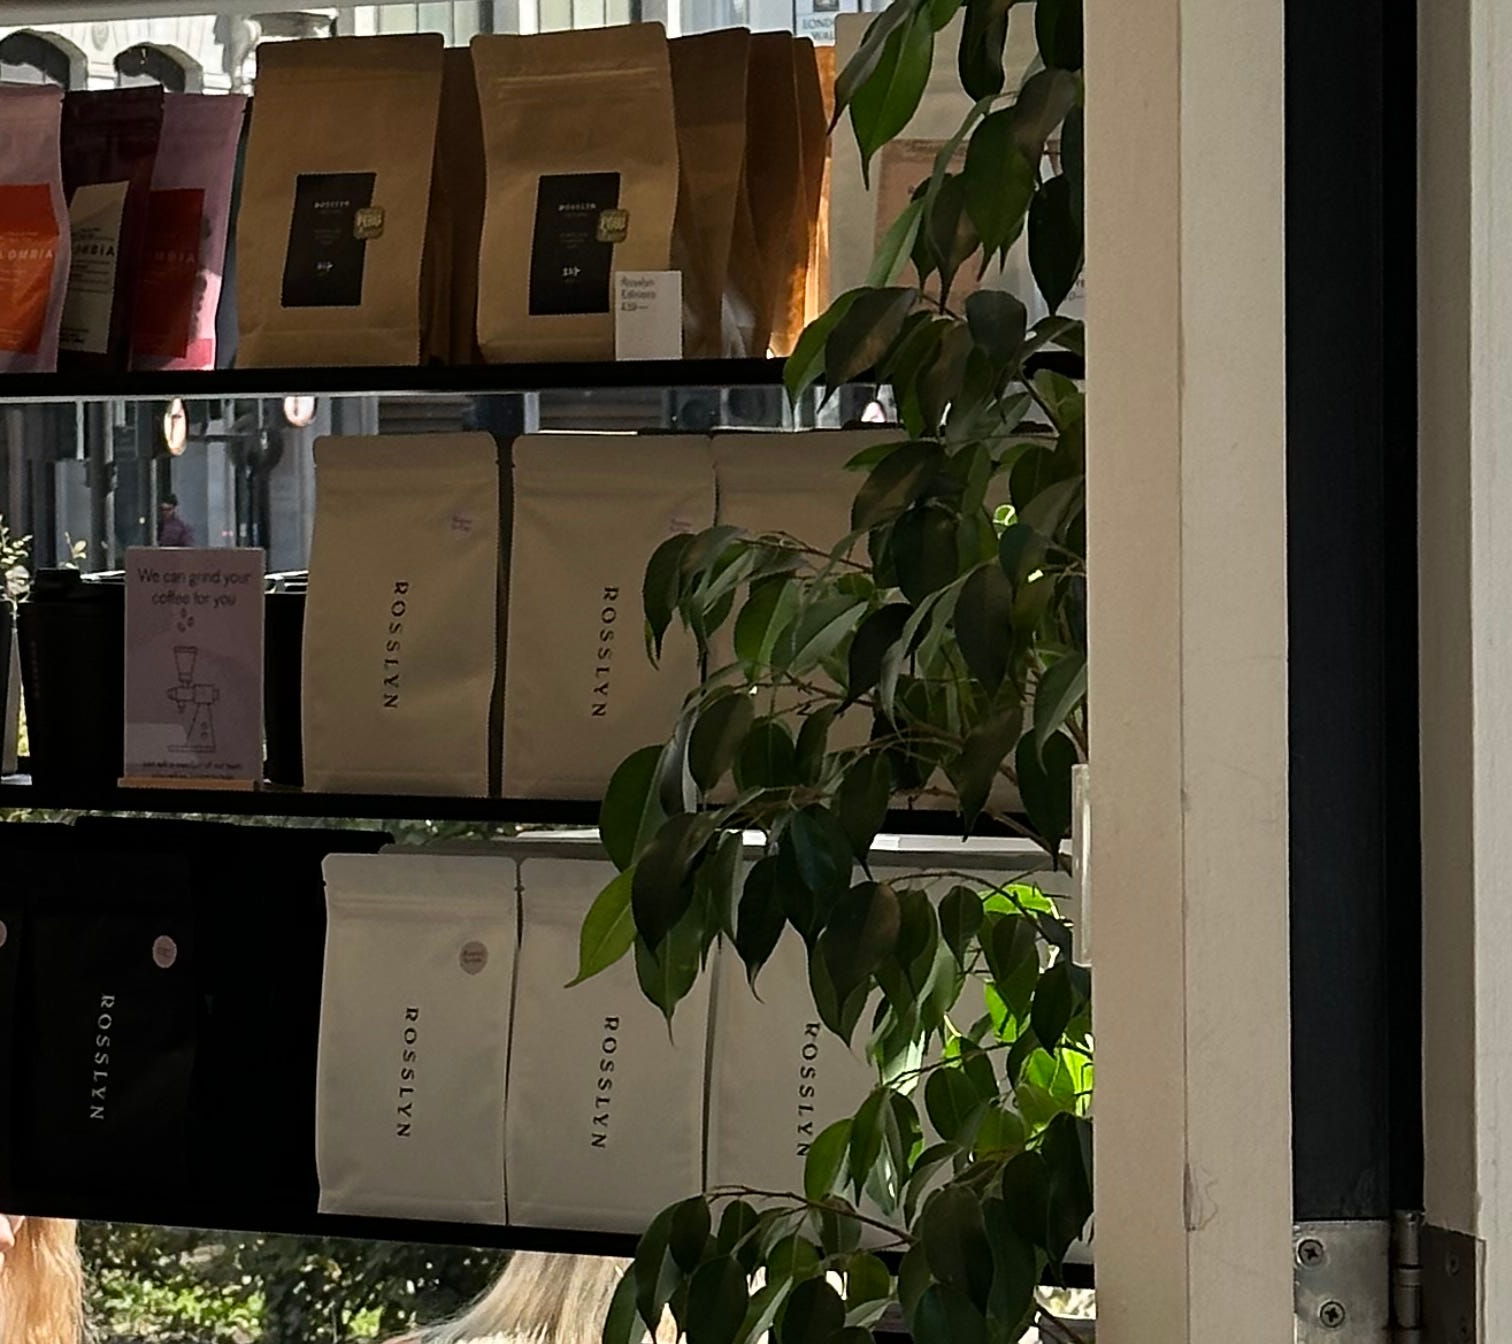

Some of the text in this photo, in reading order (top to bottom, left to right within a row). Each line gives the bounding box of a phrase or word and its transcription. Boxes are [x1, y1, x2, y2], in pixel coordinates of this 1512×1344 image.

[802, 18, 834, 30] LOND
[138, 568, 251, 588] We can grind your
[151, 590, 237, 609] coffee for you
[384, 581, 409, 709] ROSSLYN
[591, 586, 619, 717] ROSSLYN
[89, 993, 116, 1120] ROSSLYN
[396, 1007, 420, 1138] ROSSLYN
[591, 1016, 620, 1149] ROSSLYN
[796, 1022, 821, 1157] ROSSLYN
